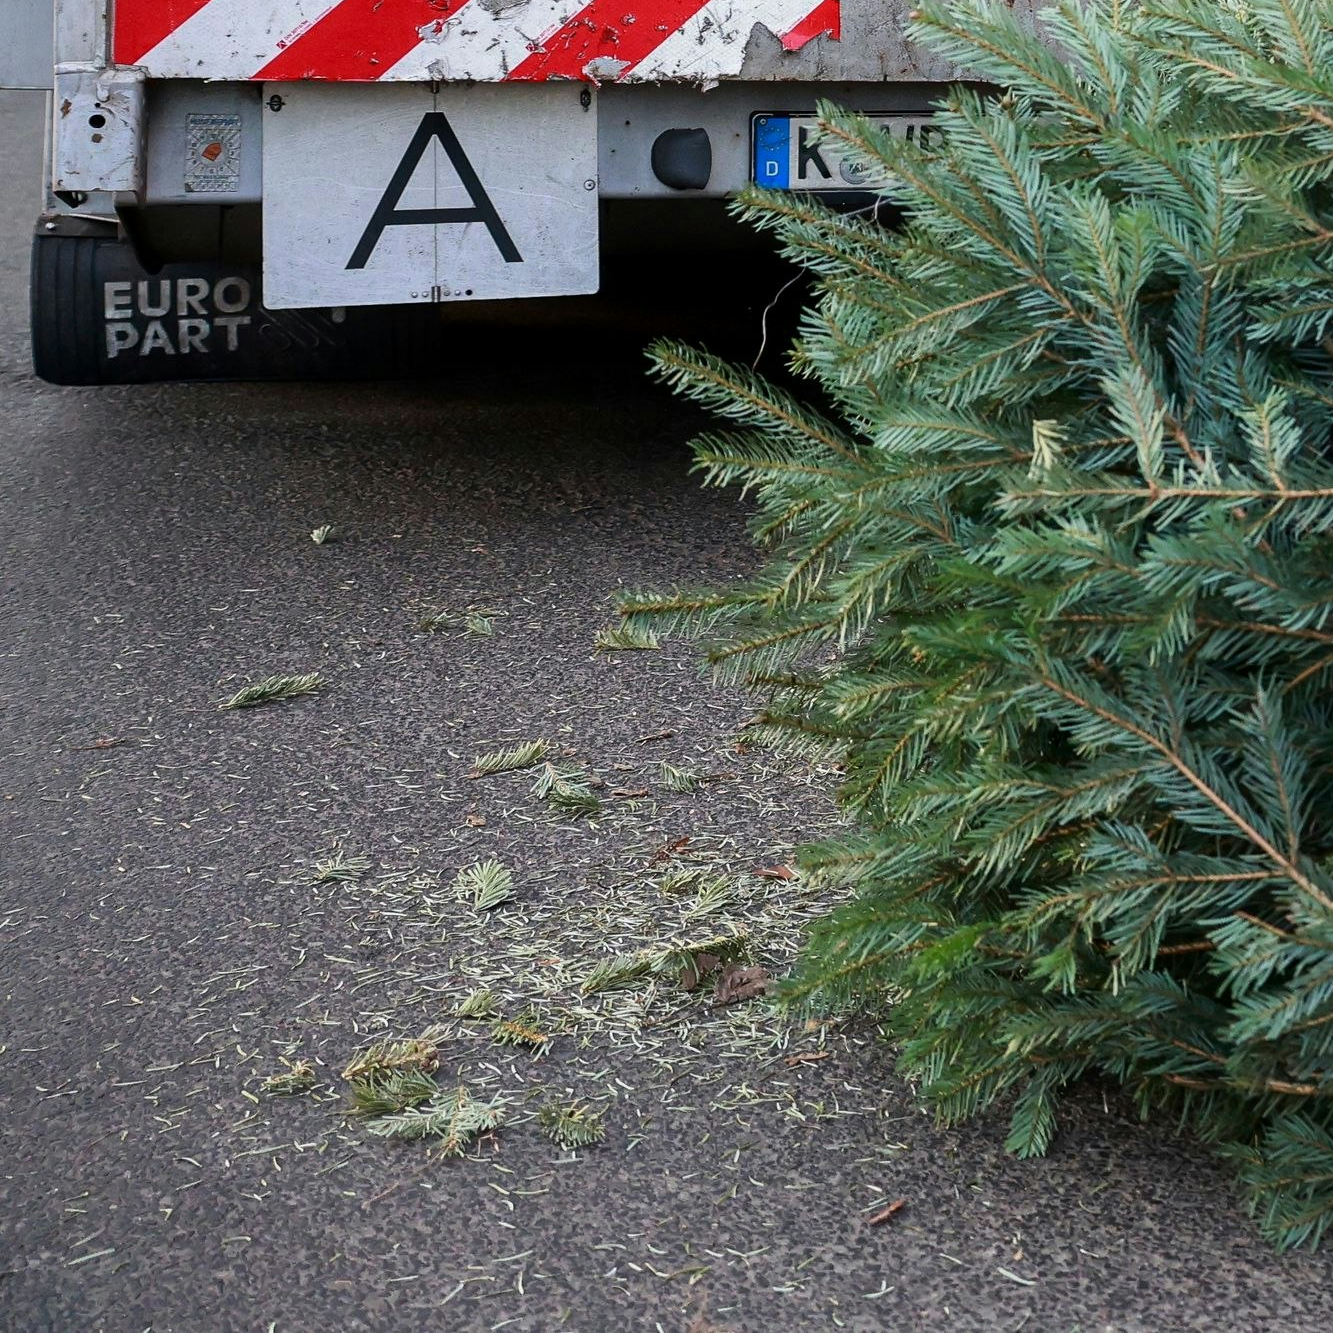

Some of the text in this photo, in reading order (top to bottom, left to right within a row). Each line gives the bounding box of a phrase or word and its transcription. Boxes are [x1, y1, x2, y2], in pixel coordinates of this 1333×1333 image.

[765, 161, 779, 177] D
[345, 112, 524, 270] A
[104, 276, 250, 319] EURO
[105, 316, 251, 359] PART
